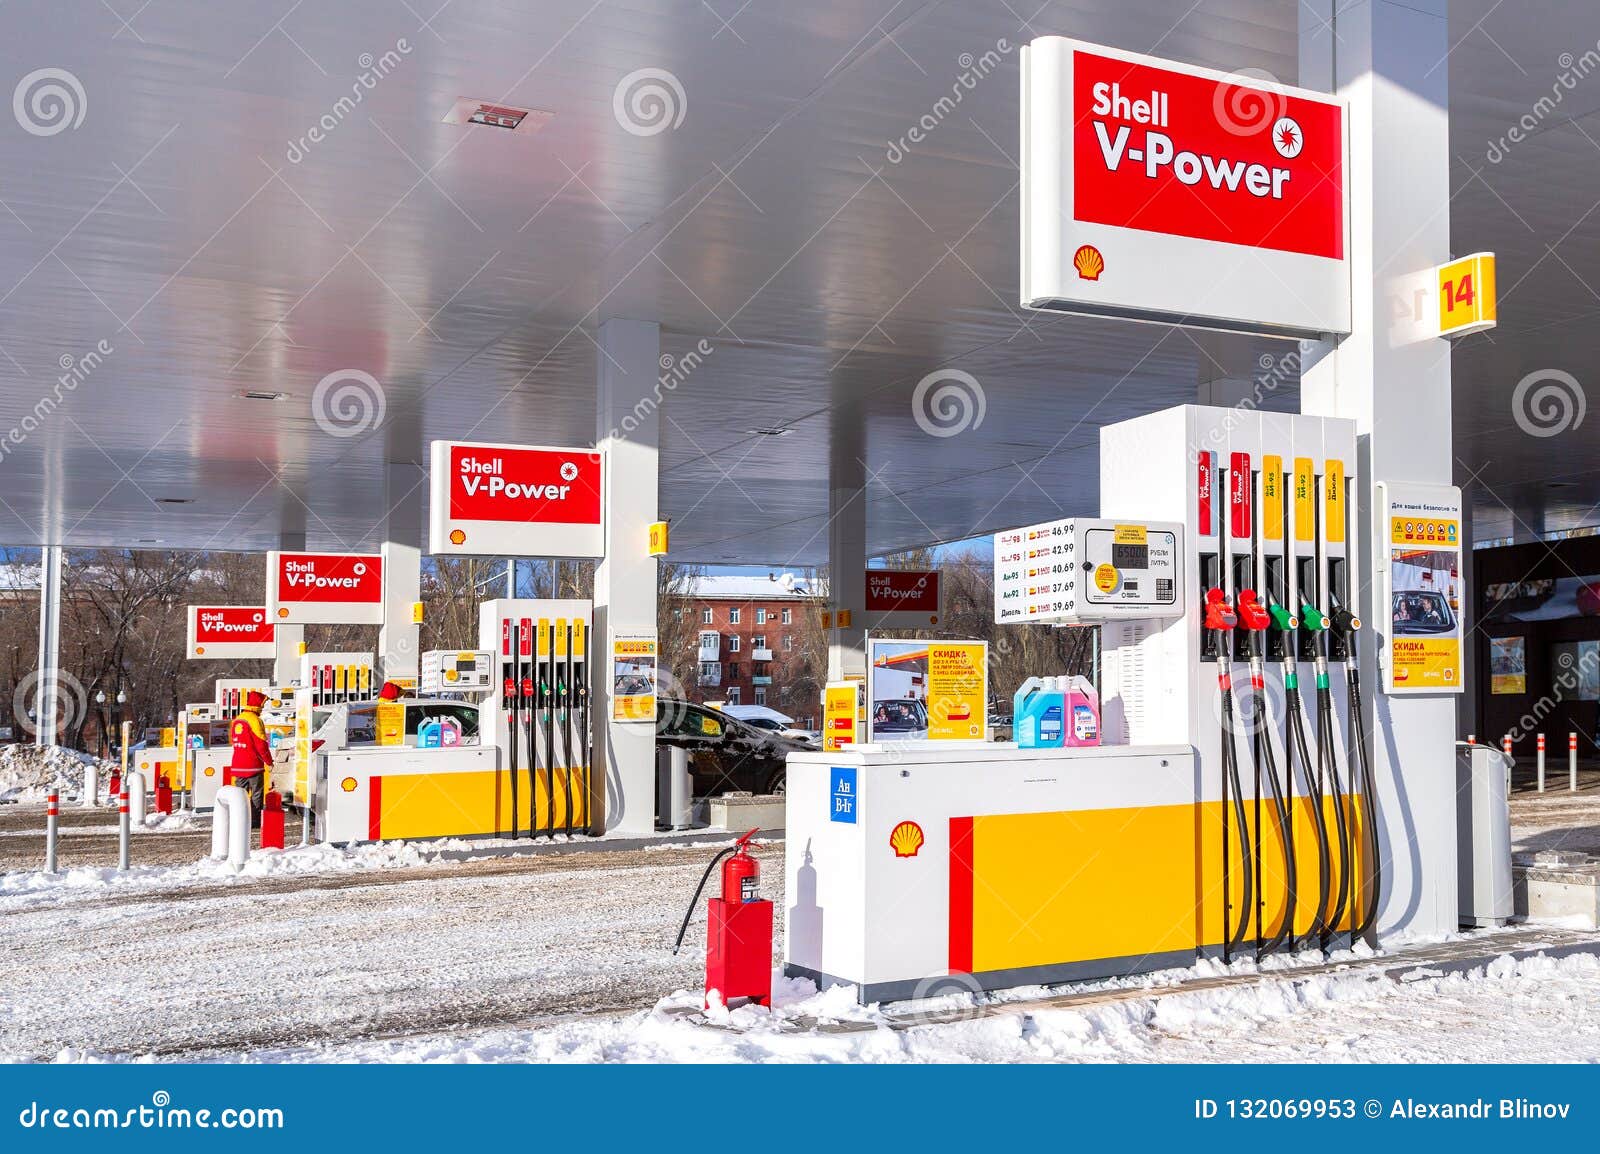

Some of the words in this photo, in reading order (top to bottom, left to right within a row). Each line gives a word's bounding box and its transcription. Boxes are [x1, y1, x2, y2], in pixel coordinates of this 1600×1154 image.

[1092, 82, 1168, 127] Shell
[1092, 120, 1291, 199] V-Power
[1442, 273, 1475, 312] 14
[461, 458, 502, 474] Shell
[461, 475, 570, 500] V-Power
[285, 560, 315, 573] Shell
[286, 572, 361, 588] V-Power
[870, 576, 891, 586] Shell
[871, 586, 922, 599] V-Power
[201, 612, 224, 622] Shell
[202, 621, 259, 633] V-Power
[1394, 642, 1425, 651] СКИДКА
[933, 650, 967, 659] СКИДКА
